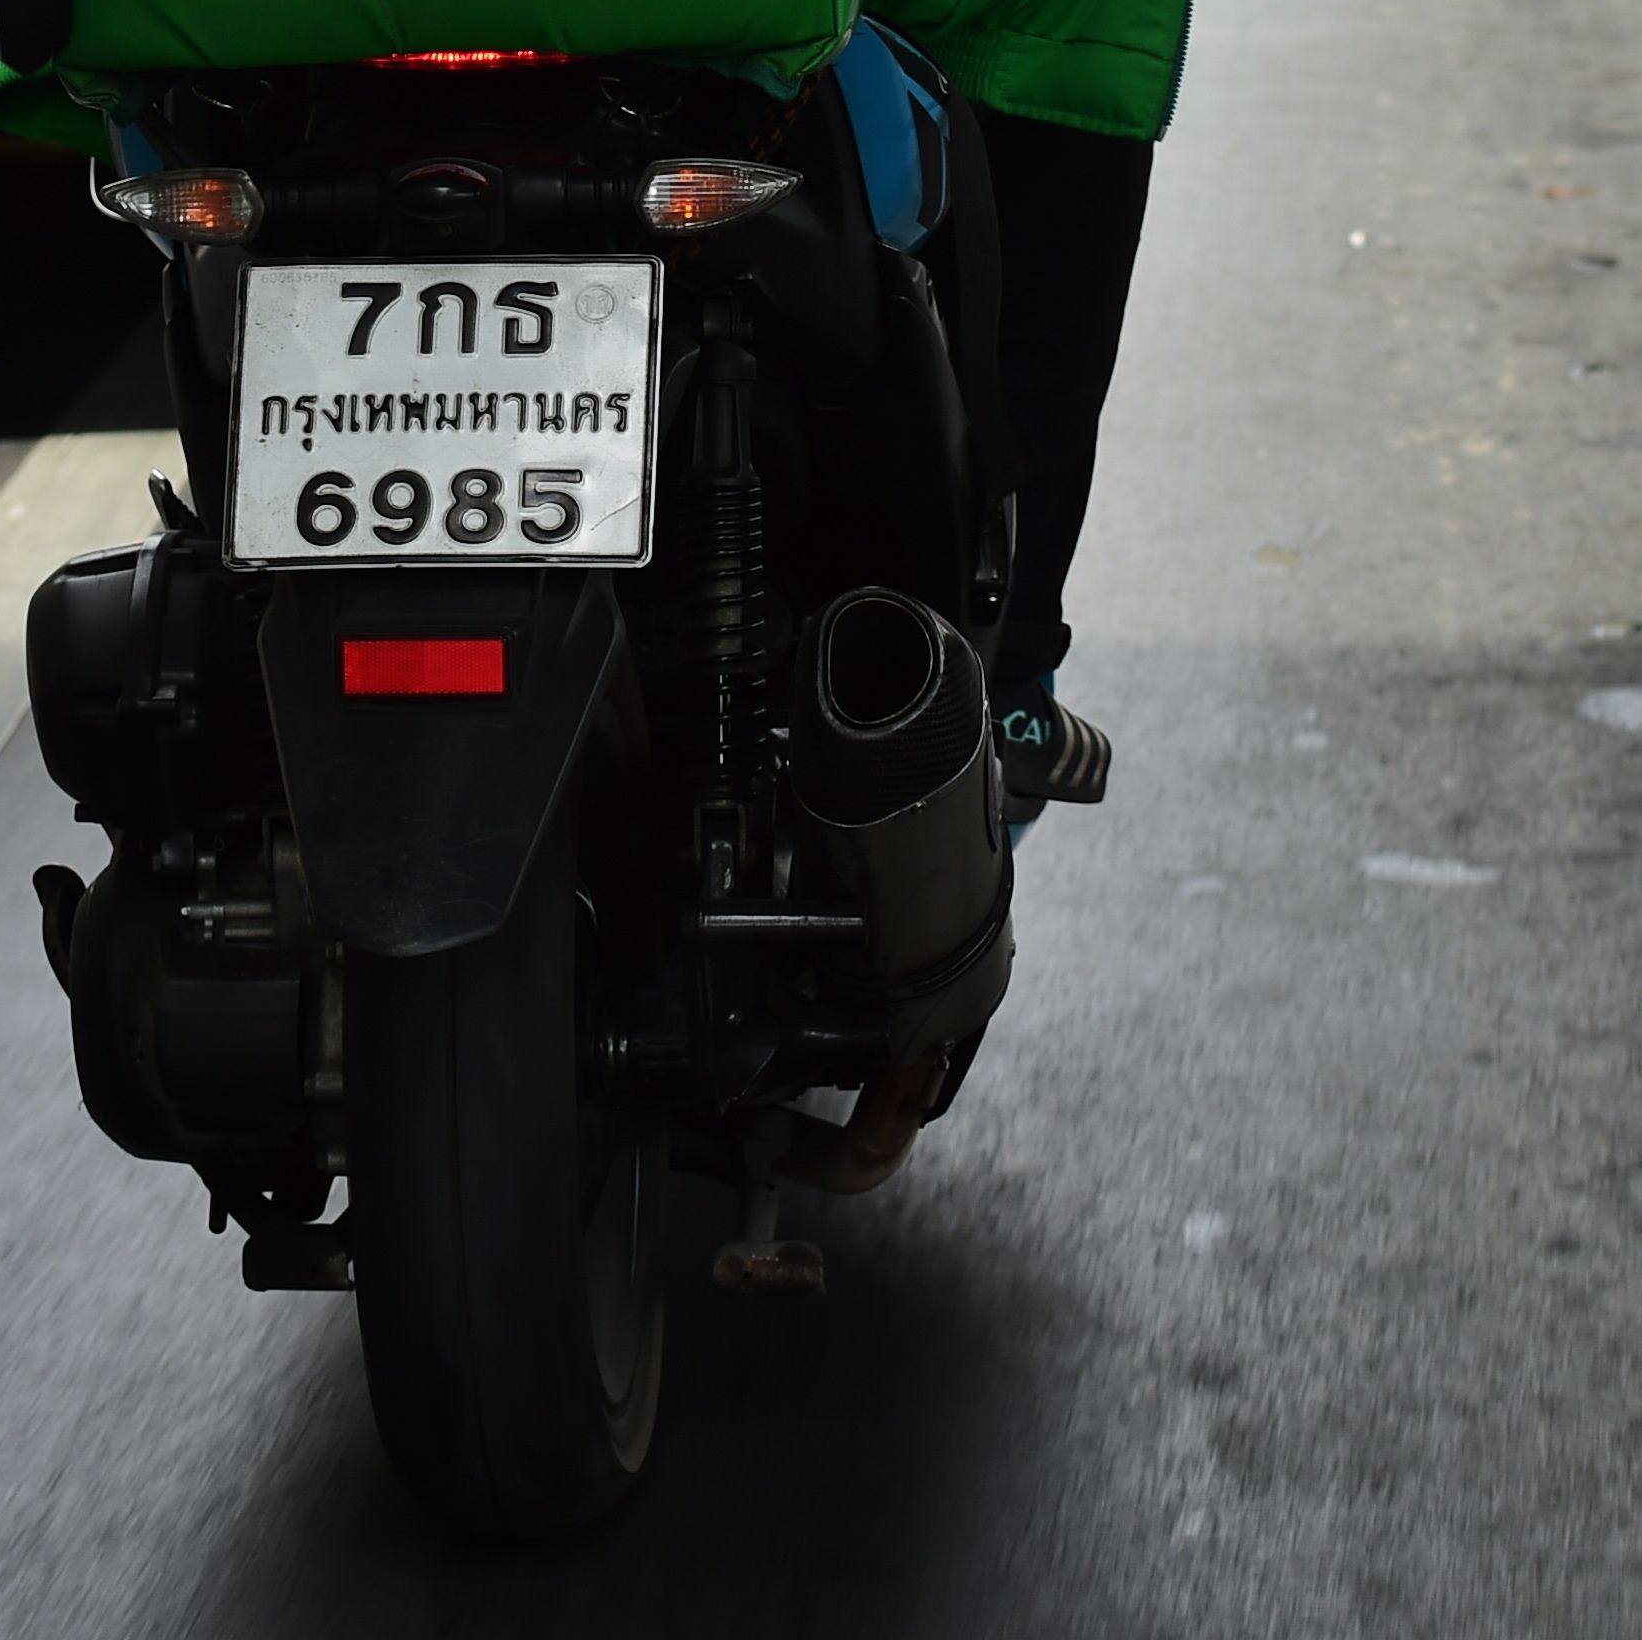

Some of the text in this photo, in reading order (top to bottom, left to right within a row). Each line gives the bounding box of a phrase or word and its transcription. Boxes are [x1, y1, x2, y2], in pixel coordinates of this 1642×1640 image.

[341, 281, 559, 356] 7กธ
[261, 392, 631, 452] กรุงเทพมหานคร
[297, 468, 584, 547] 6985
